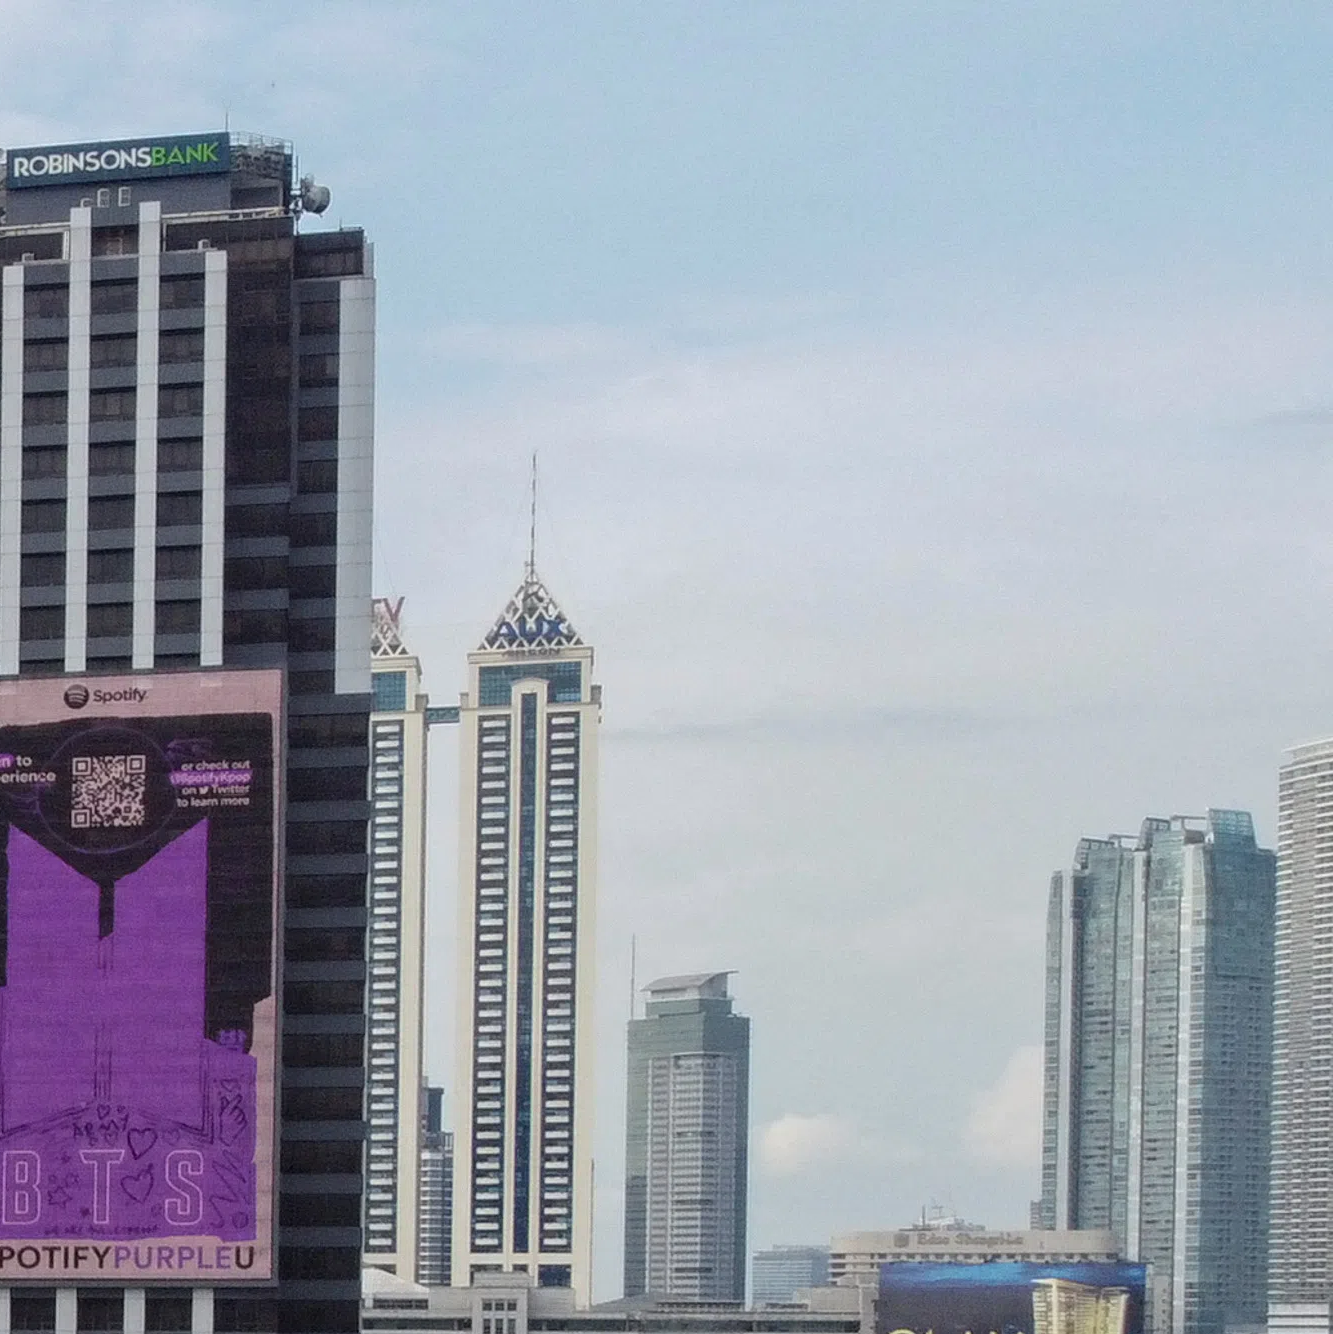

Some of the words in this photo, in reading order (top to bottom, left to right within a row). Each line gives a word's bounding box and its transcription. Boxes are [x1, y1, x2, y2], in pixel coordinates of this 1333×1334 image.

[13, 142, 220, 178] ROBINSONSBANK
[93, 687, 147, 704] Spotify
[16, 755, 32, 767] to
[195, 761, 229, 771] check
[181, 786, 197, 795] on
[176, 798, 189, 807] to
